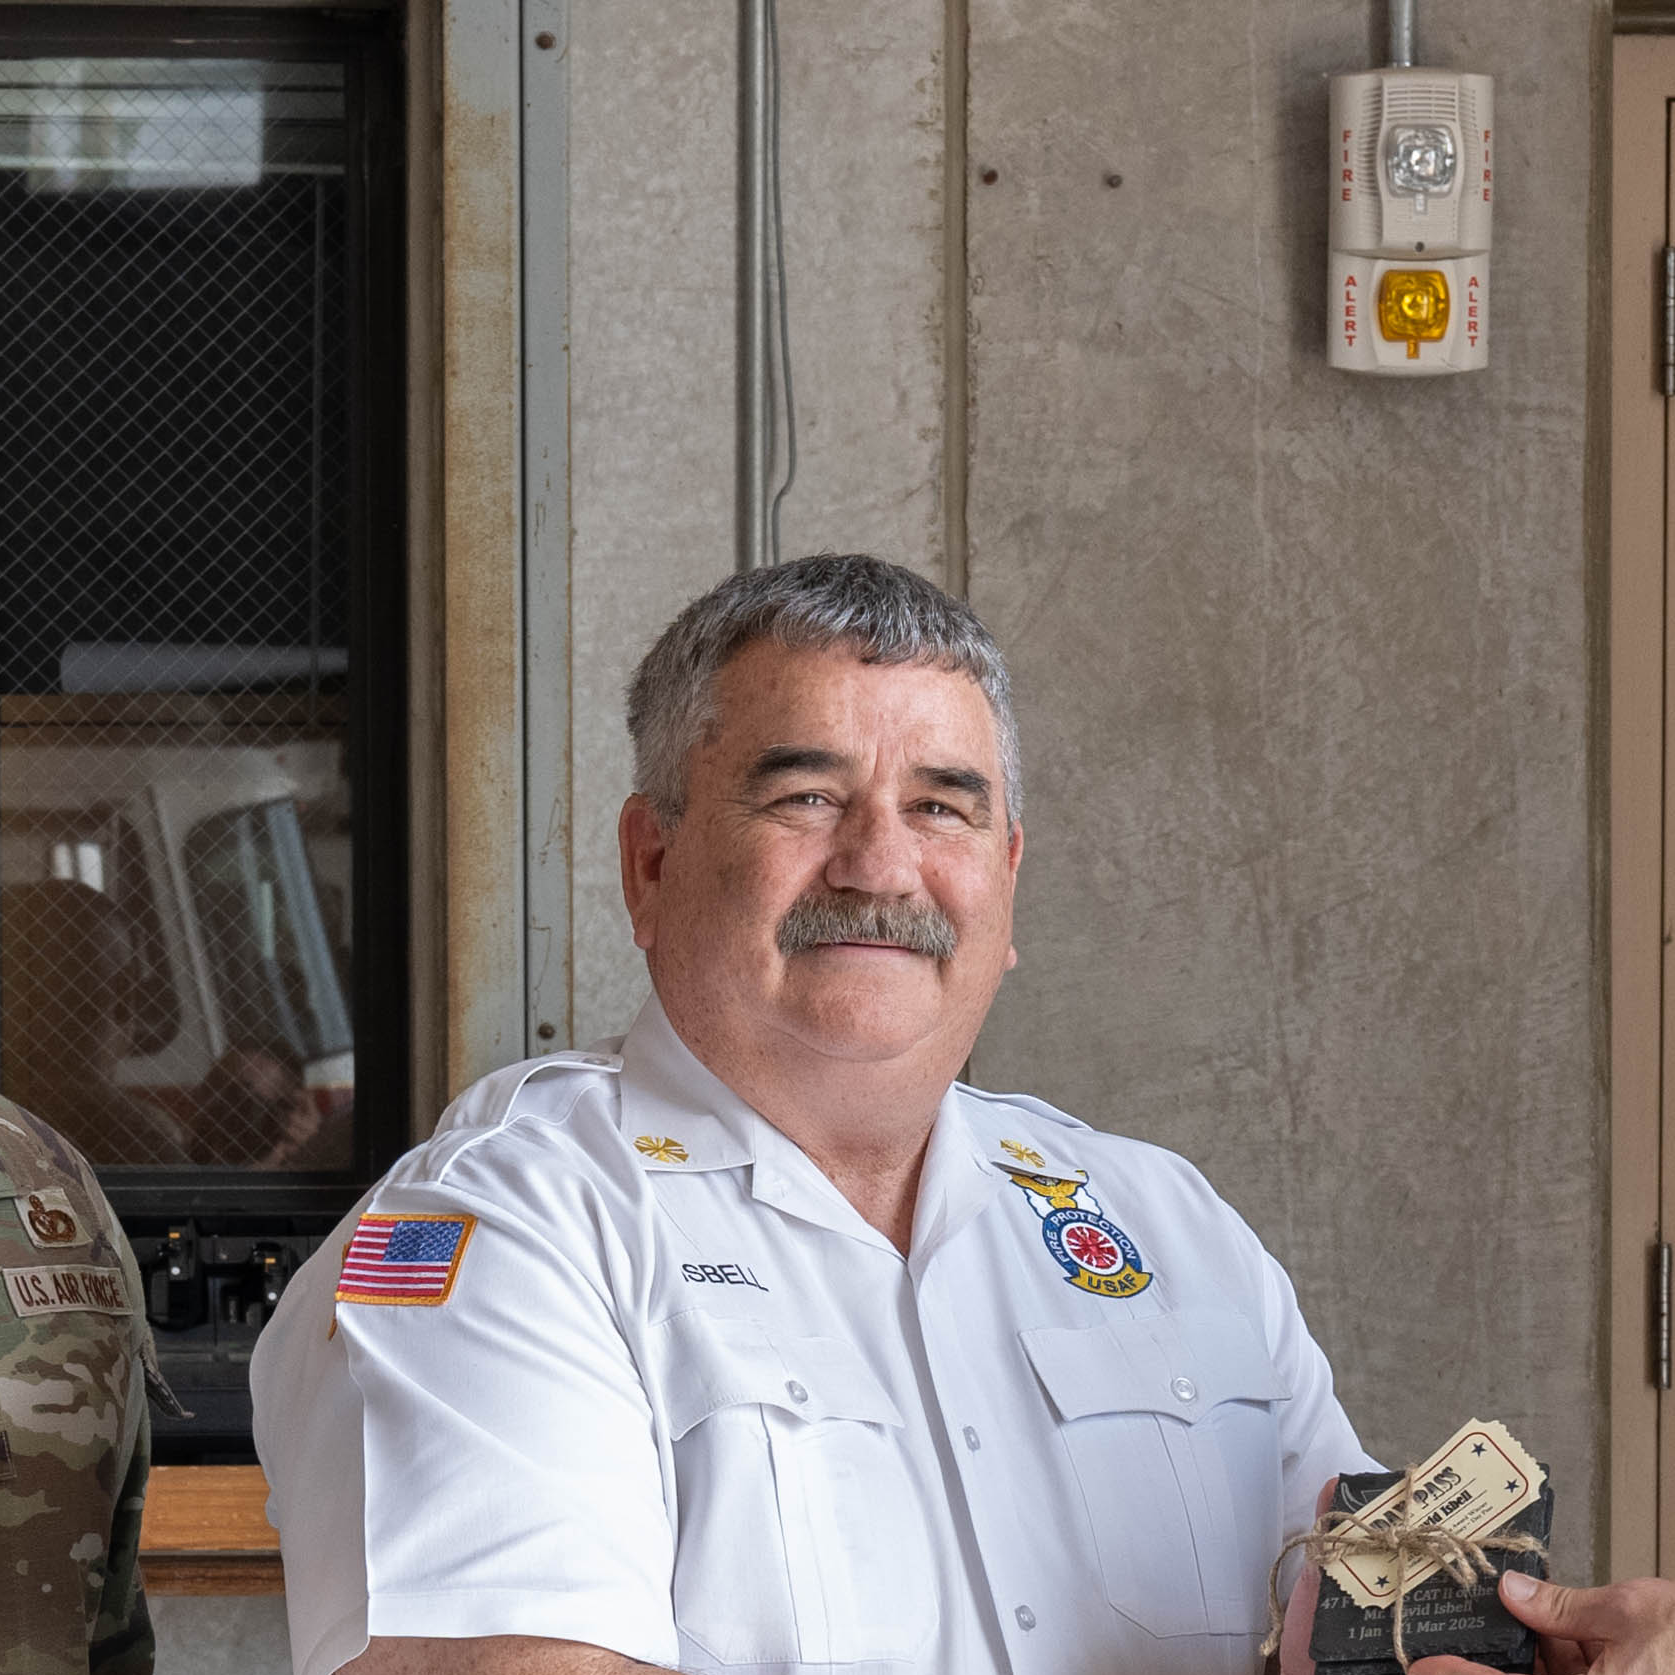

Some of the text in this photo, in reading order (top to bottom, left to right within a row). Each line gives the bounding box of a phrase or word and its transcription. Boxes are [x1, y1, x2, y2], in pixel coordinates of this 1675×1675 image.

[1342, 130, 1353, 201] FIRE
[1483, 130, 1492, 201] FIRE
[1344, 276, 1357, 346] ALERT
[1467, 276, 1479, 347] ALERT
[1046, 1210, 1137, 1262] FIRE PROTECTION
[14, 1272, 126, 1308] U.S. AIR FORCE
[1088, 1273, 1137, 1293] USAF
[1413, 1466, 1461, 1510] PASS
[1441, 1490, 1473, 1516] Isbell
[1359, 1626, 1382, 1641] Jan
[1417, 1620, 1445, 1633] Mar
[1448, 1615, 1486, 1631] 2025
[1364, 1608, 1386, 1621] Mr.
[1434, 1600, 1472, 1615] Isbell
